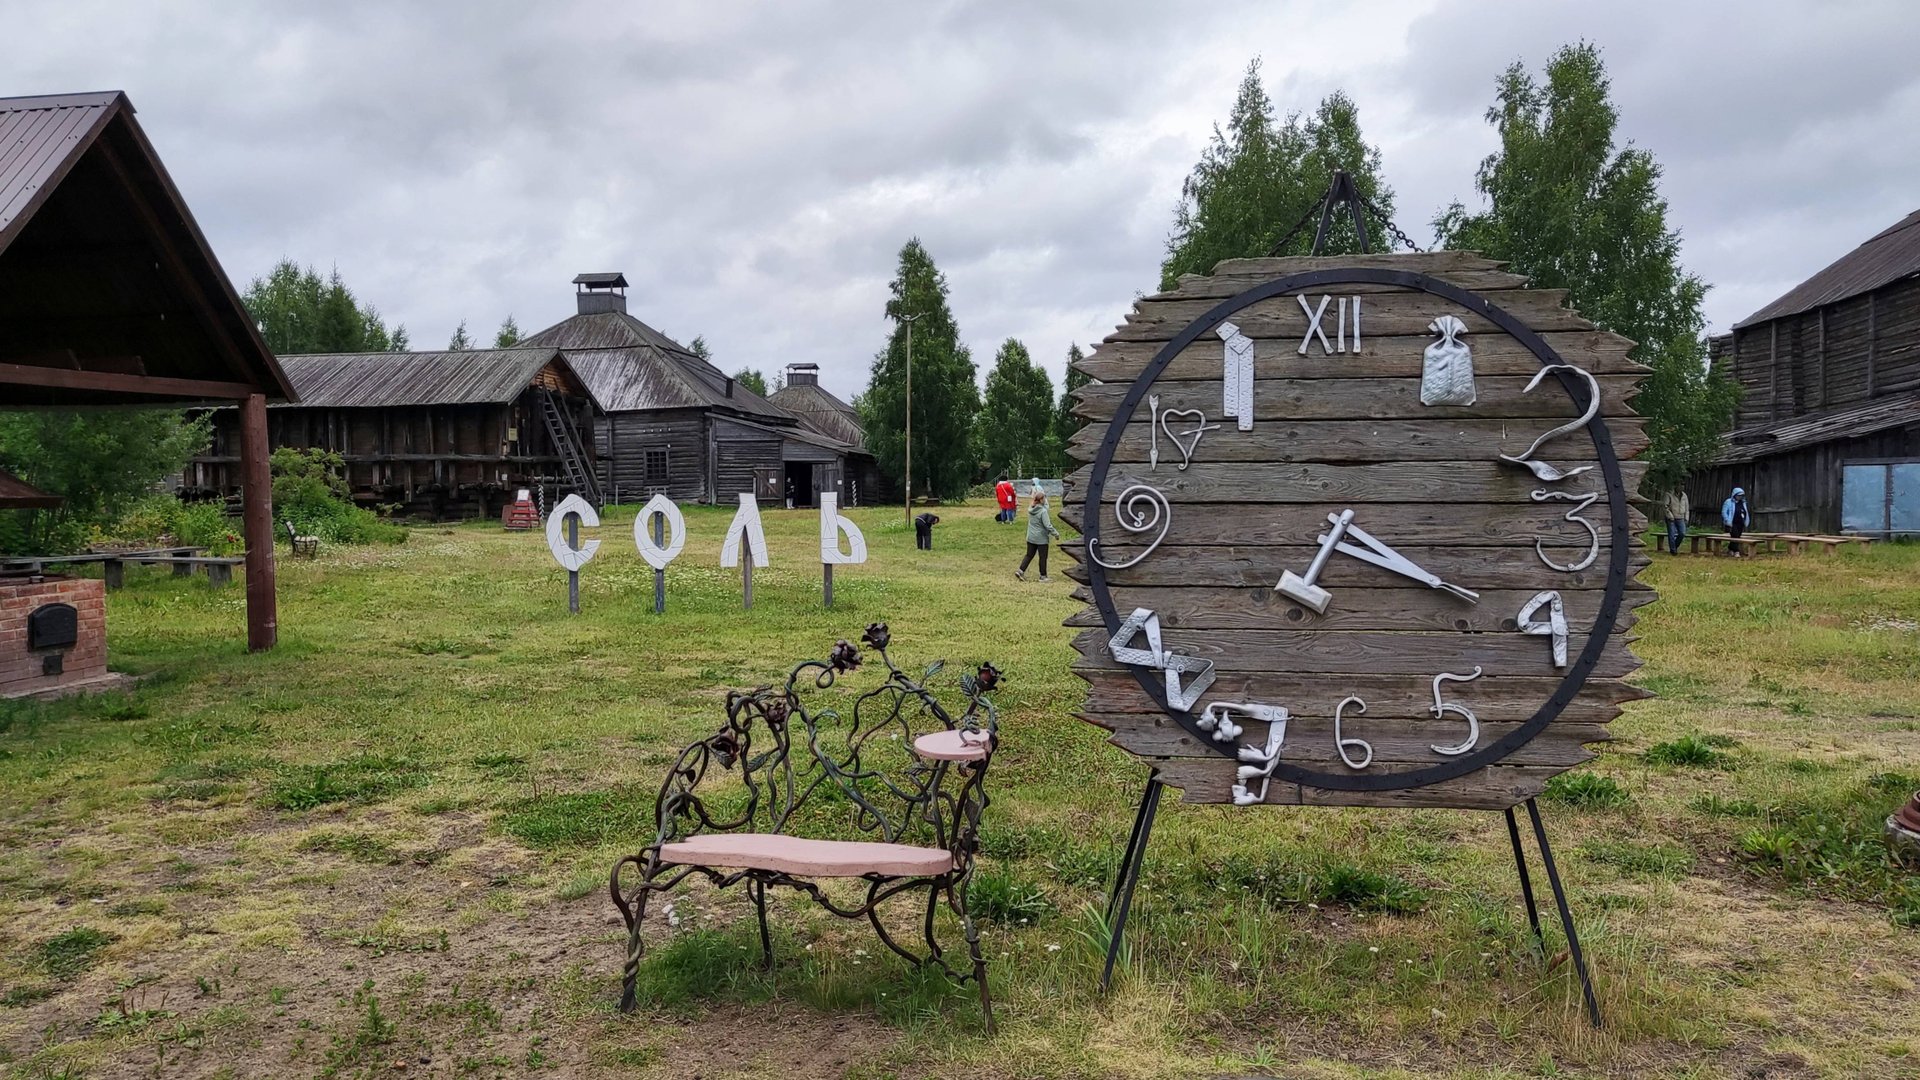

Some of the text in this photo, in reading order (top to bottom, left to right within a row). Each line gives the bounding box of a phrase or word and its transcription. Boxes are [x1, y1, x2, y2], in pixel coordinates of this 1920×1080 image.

[1296, 293, 1362, 355] XII
[1499, 364, 1601, 482] 2
[546, 491, 868, 572] СОЛЬ
[1089, 485, 1172, 569] 9
[1530, 487, 1599, 573] 3
[1108, 607, 1217, 712] 8
[1516, 590, 1570, 668] 4
[1335, 692, 1373, 770] 6
[1429, 665, 1483, 757] 5
